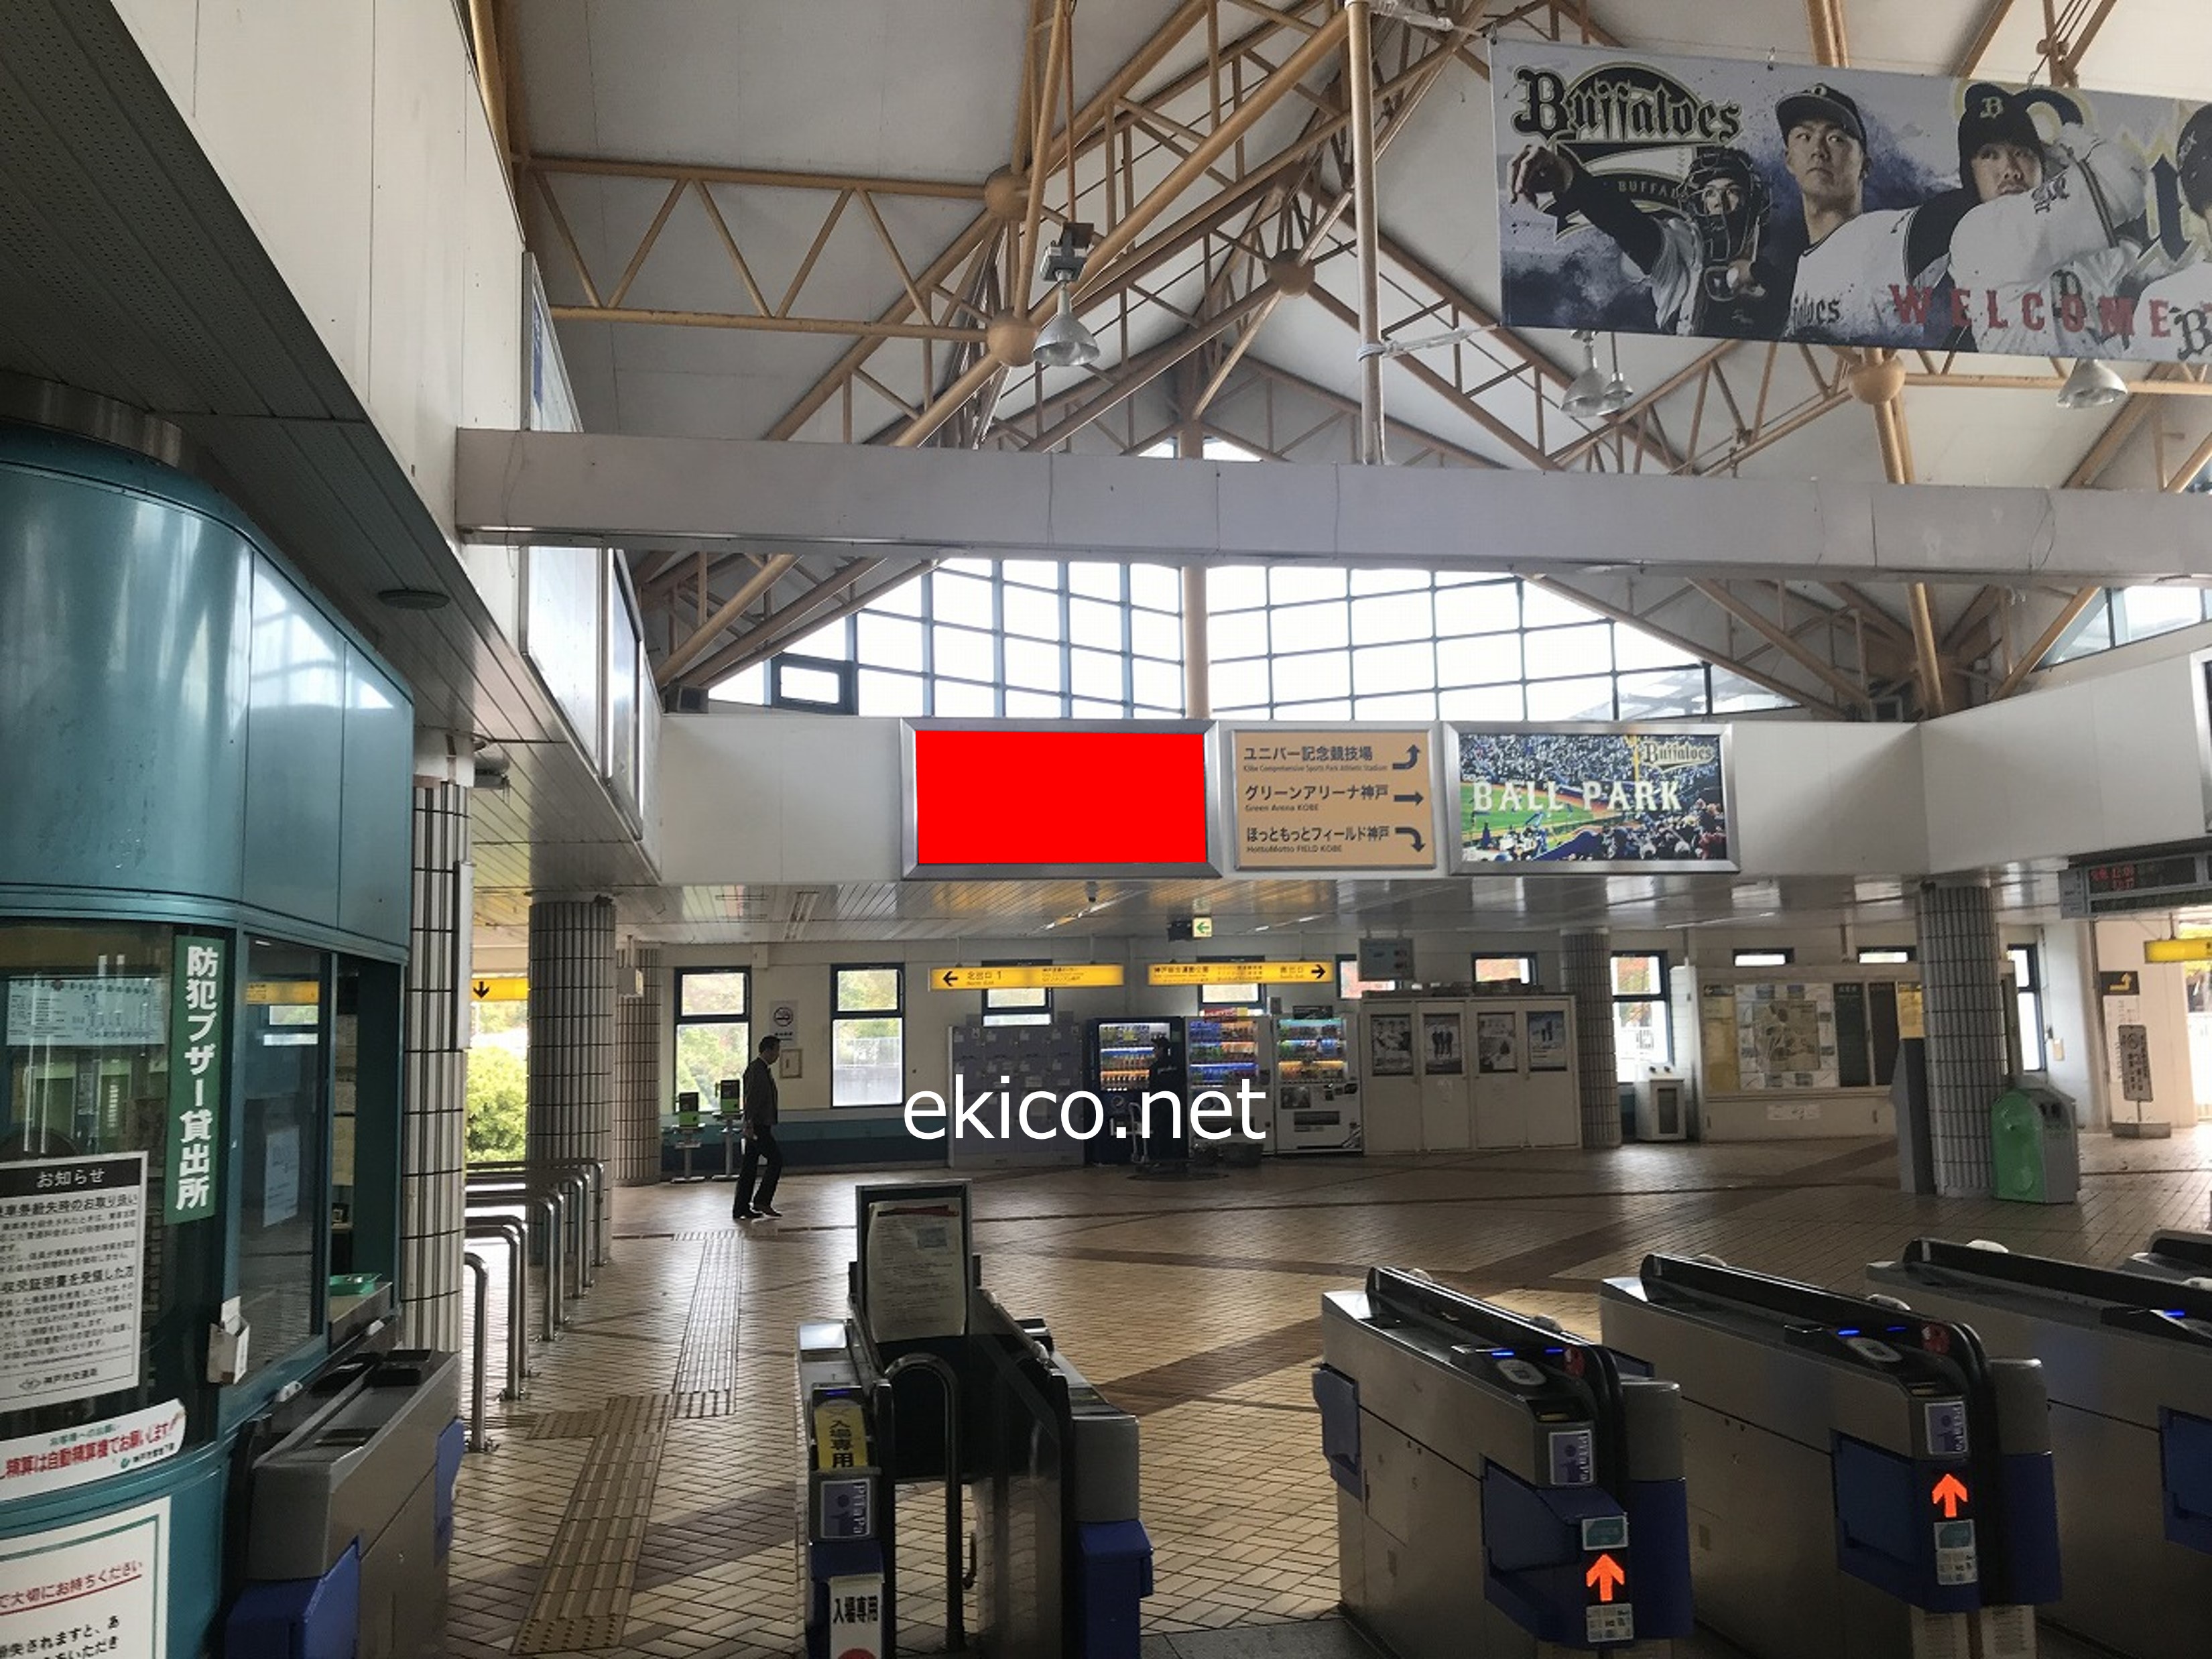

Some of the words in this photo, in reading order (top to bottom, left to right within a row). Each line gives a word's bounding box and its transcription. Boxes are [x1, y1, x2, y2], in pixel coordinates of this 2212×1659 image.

[1512, 66, 1743, 143] Buffaloes
[1617, 179, 1678, 200] BUFFAL
[1888, 284, 2171, 338] WELCOME
[1244, 746, 1373, 761] ユニバー記念競技場
[1245, 784, 1388, 800] グリーンアリーナ神戸
[1475, 780, 1565, 812] BALL
[1583, 780, 1682, 812] PARK
[1247, 825, 1390, 842] ほっともっとフィールド神戸
[176, 946, 219, 1211] 防犯ブザー貸出所
[36, 1168, 105, 1188] お知らせ
[0, 1193, 137, 1217] 車券紛失時のお取り扱い
[829, 1420, 854, 1468] 入場専用
[833, 1595, 878, 1624] 入場専用
[108, 1615, 120, 1630] あ
